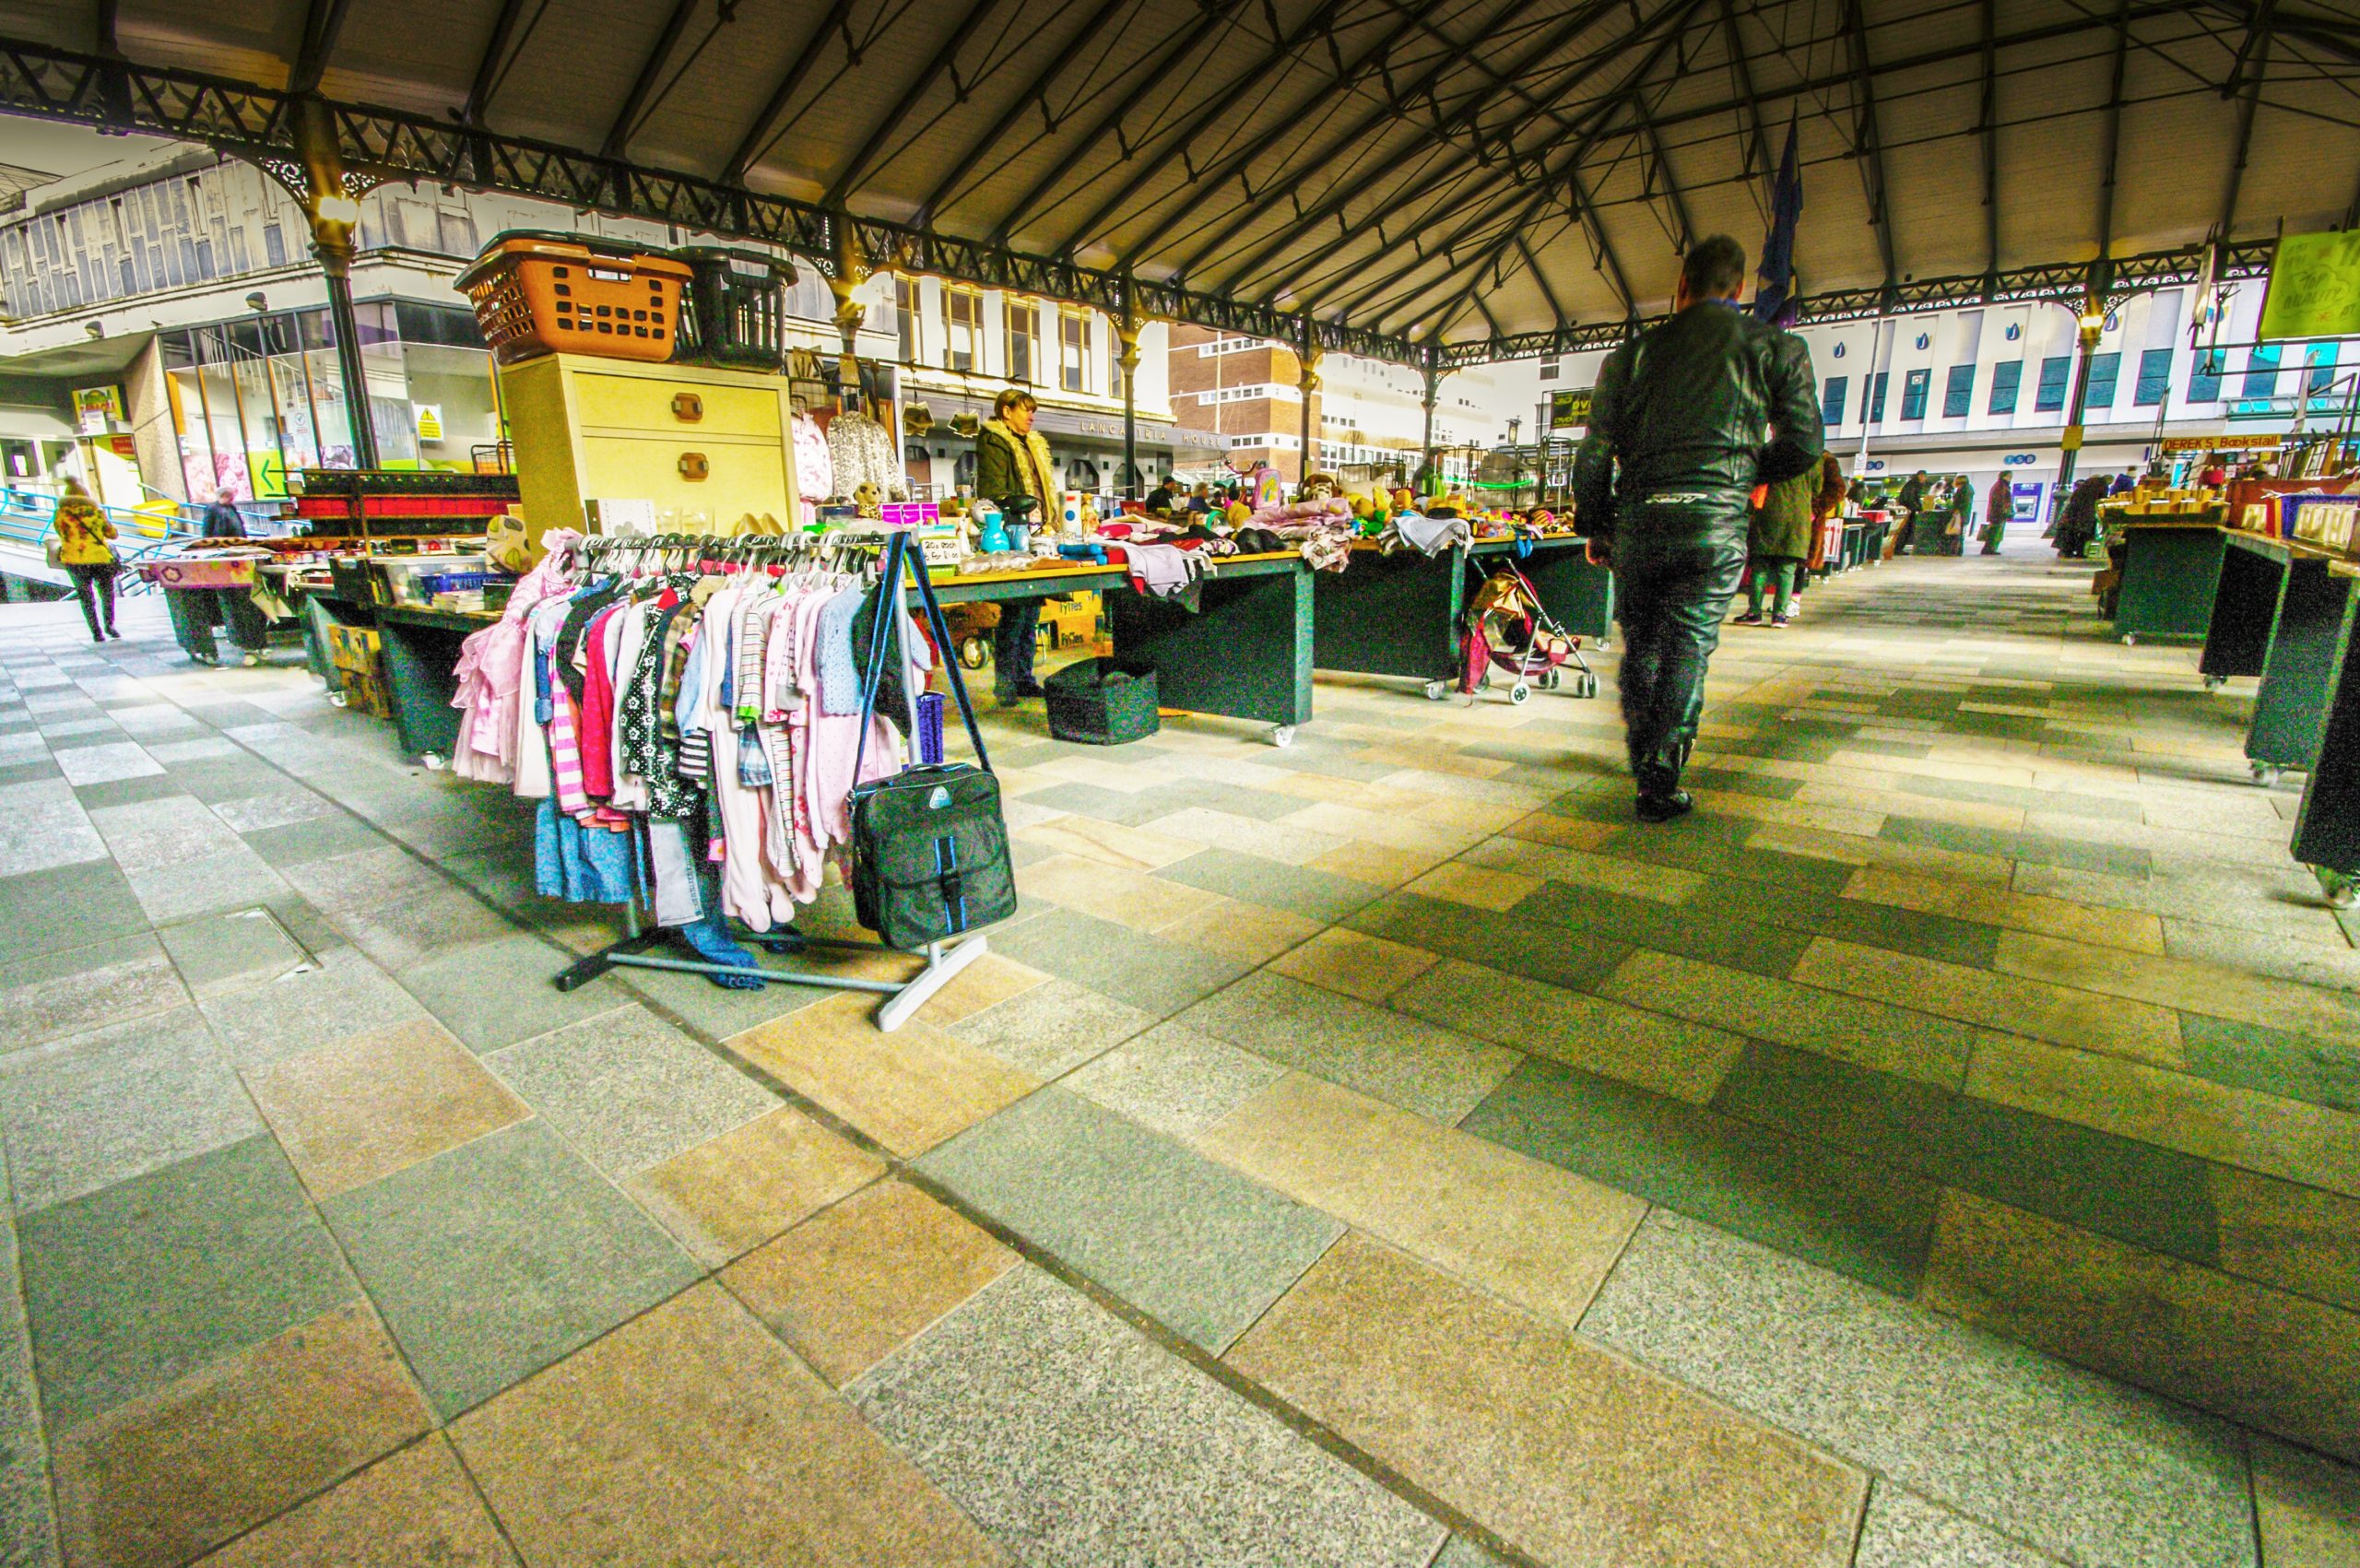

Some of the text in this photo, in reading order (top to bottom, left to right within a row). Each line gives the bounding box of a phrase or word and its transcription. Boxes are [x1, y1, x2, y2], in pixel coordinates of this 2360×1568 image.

[1080, 422, 1221, 447] LANCATRIA HOUSE
[2220, 435, 2278, 448] Bookstall
[1866, 460, 1884, 471] SB
[2004, 454, 2036, 465] TSB
